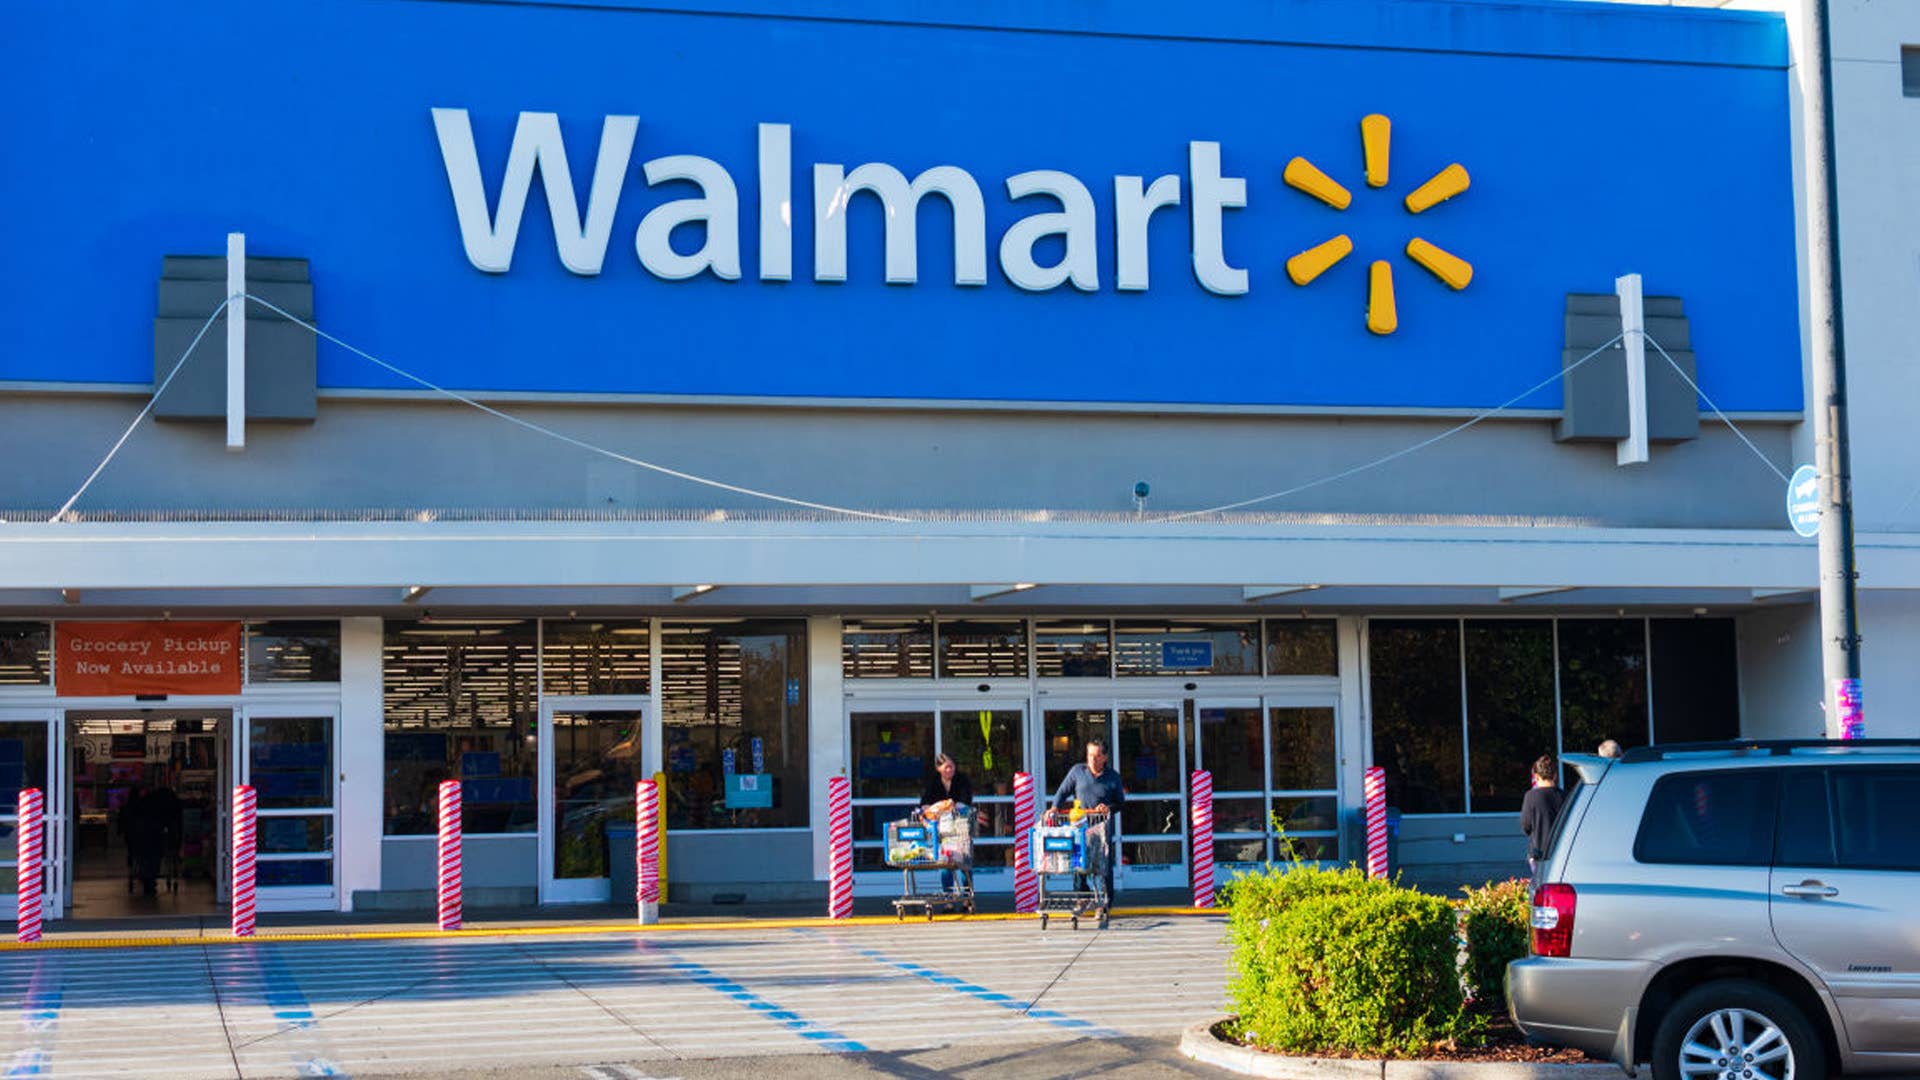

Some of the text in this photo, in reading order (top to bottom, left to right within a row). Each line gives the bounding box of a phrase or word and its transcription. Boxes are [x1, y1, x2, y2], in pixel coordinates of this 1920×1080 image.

[431, 107, 1249, 296] Walmart
[70, 637, 232, 656] Grocery Pickup
[76, 660, 222, 675] Now Available
